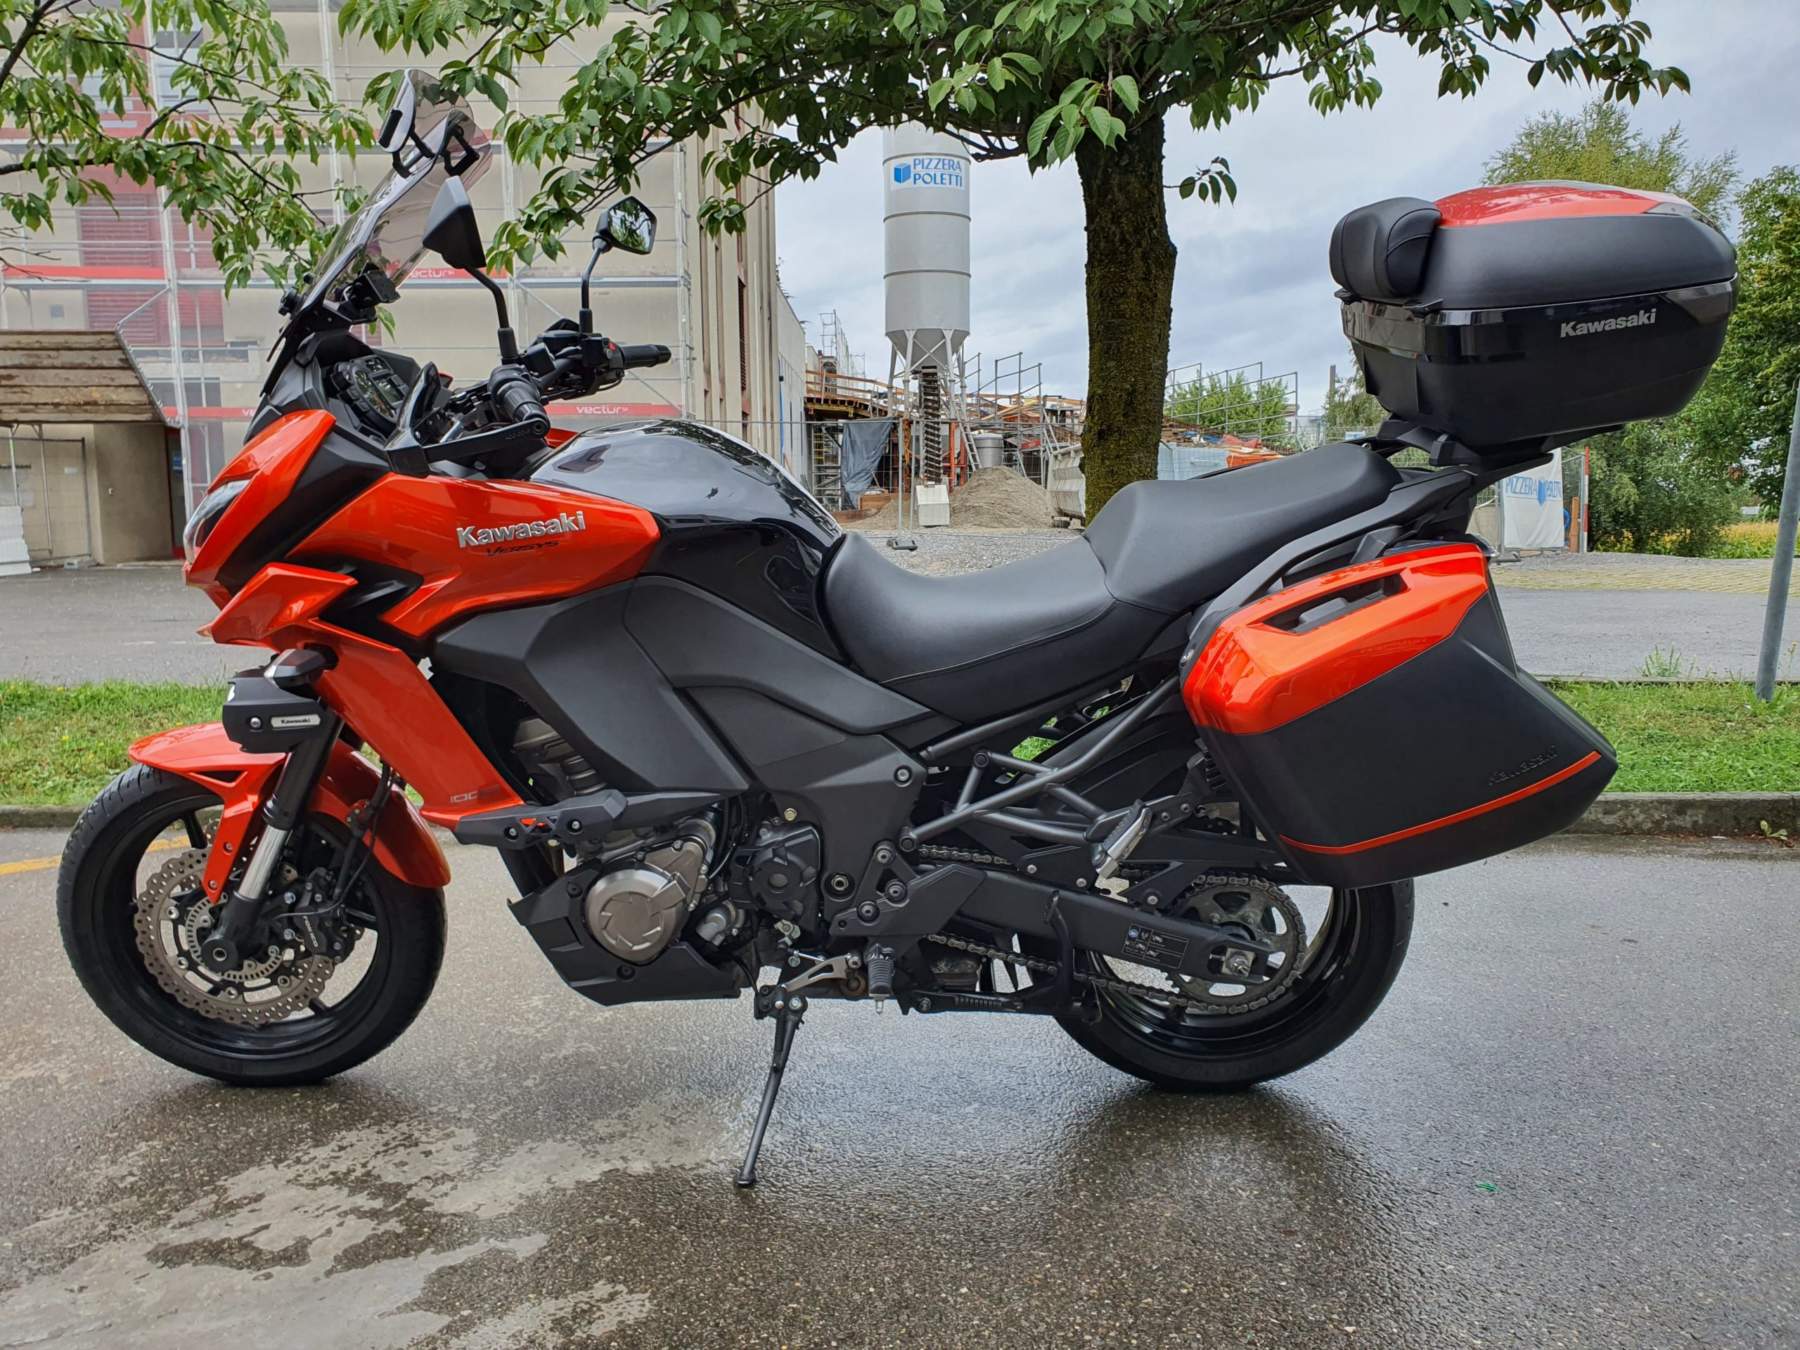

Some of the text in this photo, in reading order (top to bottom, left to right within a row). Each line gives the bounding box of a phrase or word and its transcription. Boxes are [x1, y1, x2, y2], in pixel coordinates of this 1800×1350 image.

[913, 157, 962, 172] PIZZERA
[913, 172, 963, 187] POLETTI
[1560, 308, 1657, 338] Kawasaki
[456, 510, 586, 548] Kawasaki
